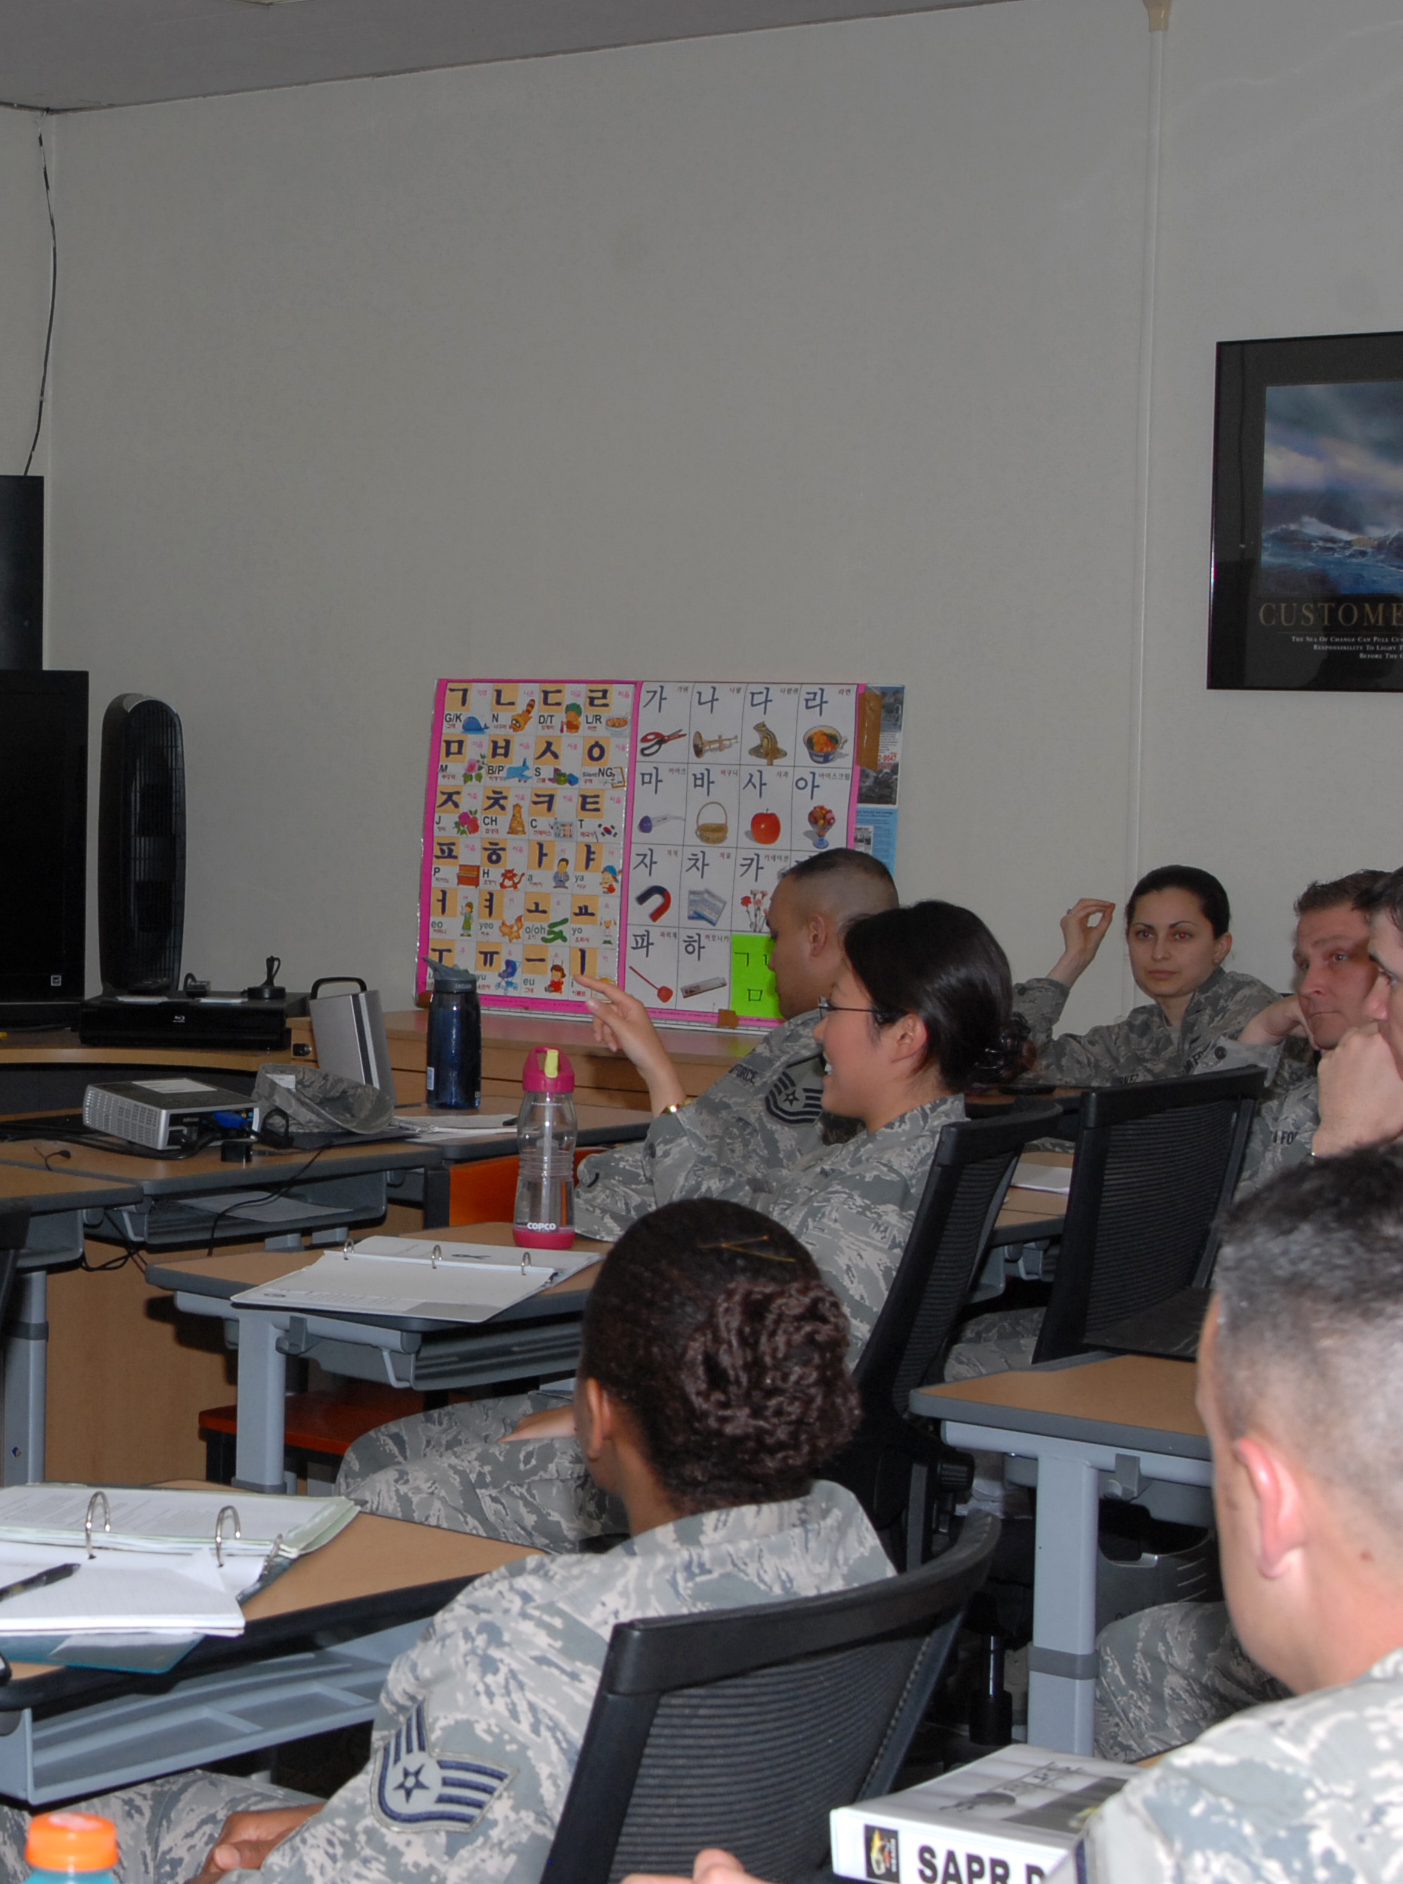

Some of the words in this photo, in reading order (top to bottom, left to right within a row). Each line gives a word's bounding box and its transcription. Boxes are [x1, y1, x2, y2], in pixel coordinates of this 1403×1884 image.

[643, 685, 667, 713] 가
[697, 686, 719, 714] 나
[750, 687, 772, 715] 다
[804, 688, 828, 716] 라
[445, 713, 462, 723] G/K
[492, 714, 499, 723] N
[539, 715, 554, 724] D/T
[586, 715, 602, 724] L/R
[488, 765, 504, 775] B/P
[535, 767, 541, 777] S
[598, 768, 613, 777] NG
[640, 767, 663, 794] 마
[693, 768, 714, 797] 바
[743, 770, 767, 798] 사
[795, 771, 820, 800] 아
[435, 816, 441, 825] J
[483, 816, 497, 826] CH
[531, 819, 537, 828] C
[578, 819, 584, 828] T
[633, 848, 657, 876] 자
[686, 851, 709, 879] 차
[739, 853, 764, 882] 카
[434, 868, 440, 876] P
[482, 869, 489, 878] H
[575, 874, 584, 883] ya
[479, 922, 494, 931] yeo
[525, 925, 546, 935] o/oh
[572, 926, 583, 935] yo
[631, 930, 654, 958] 파
[683, 933, 705, 961] 하
[527, 1221, 557, 1231] COPCO
[917, 1844, 1010, 1884] SAPR
